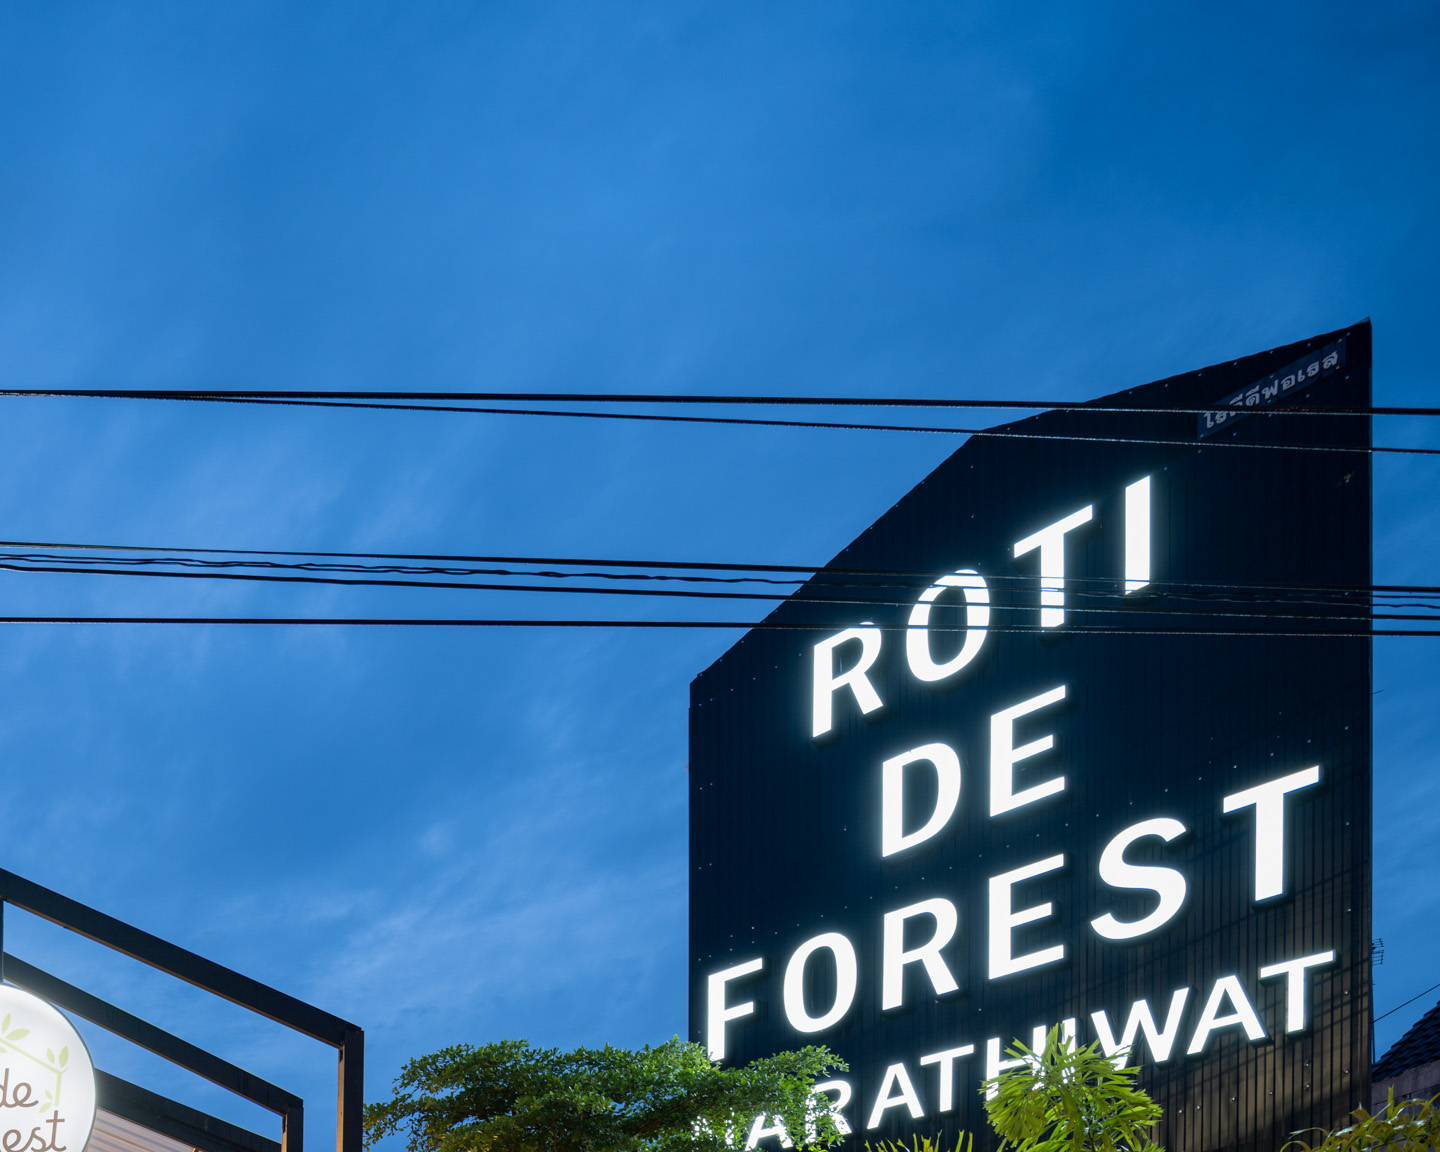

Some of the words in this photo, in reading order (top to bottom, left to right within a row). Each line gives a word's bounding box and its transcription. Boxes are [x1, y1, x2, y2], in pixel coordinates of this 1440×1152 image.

[812, 476, 1151, 738] ROTI
[882, 686, 1066, 858] DE
[707, 766, 1319, 1062] FOREST
